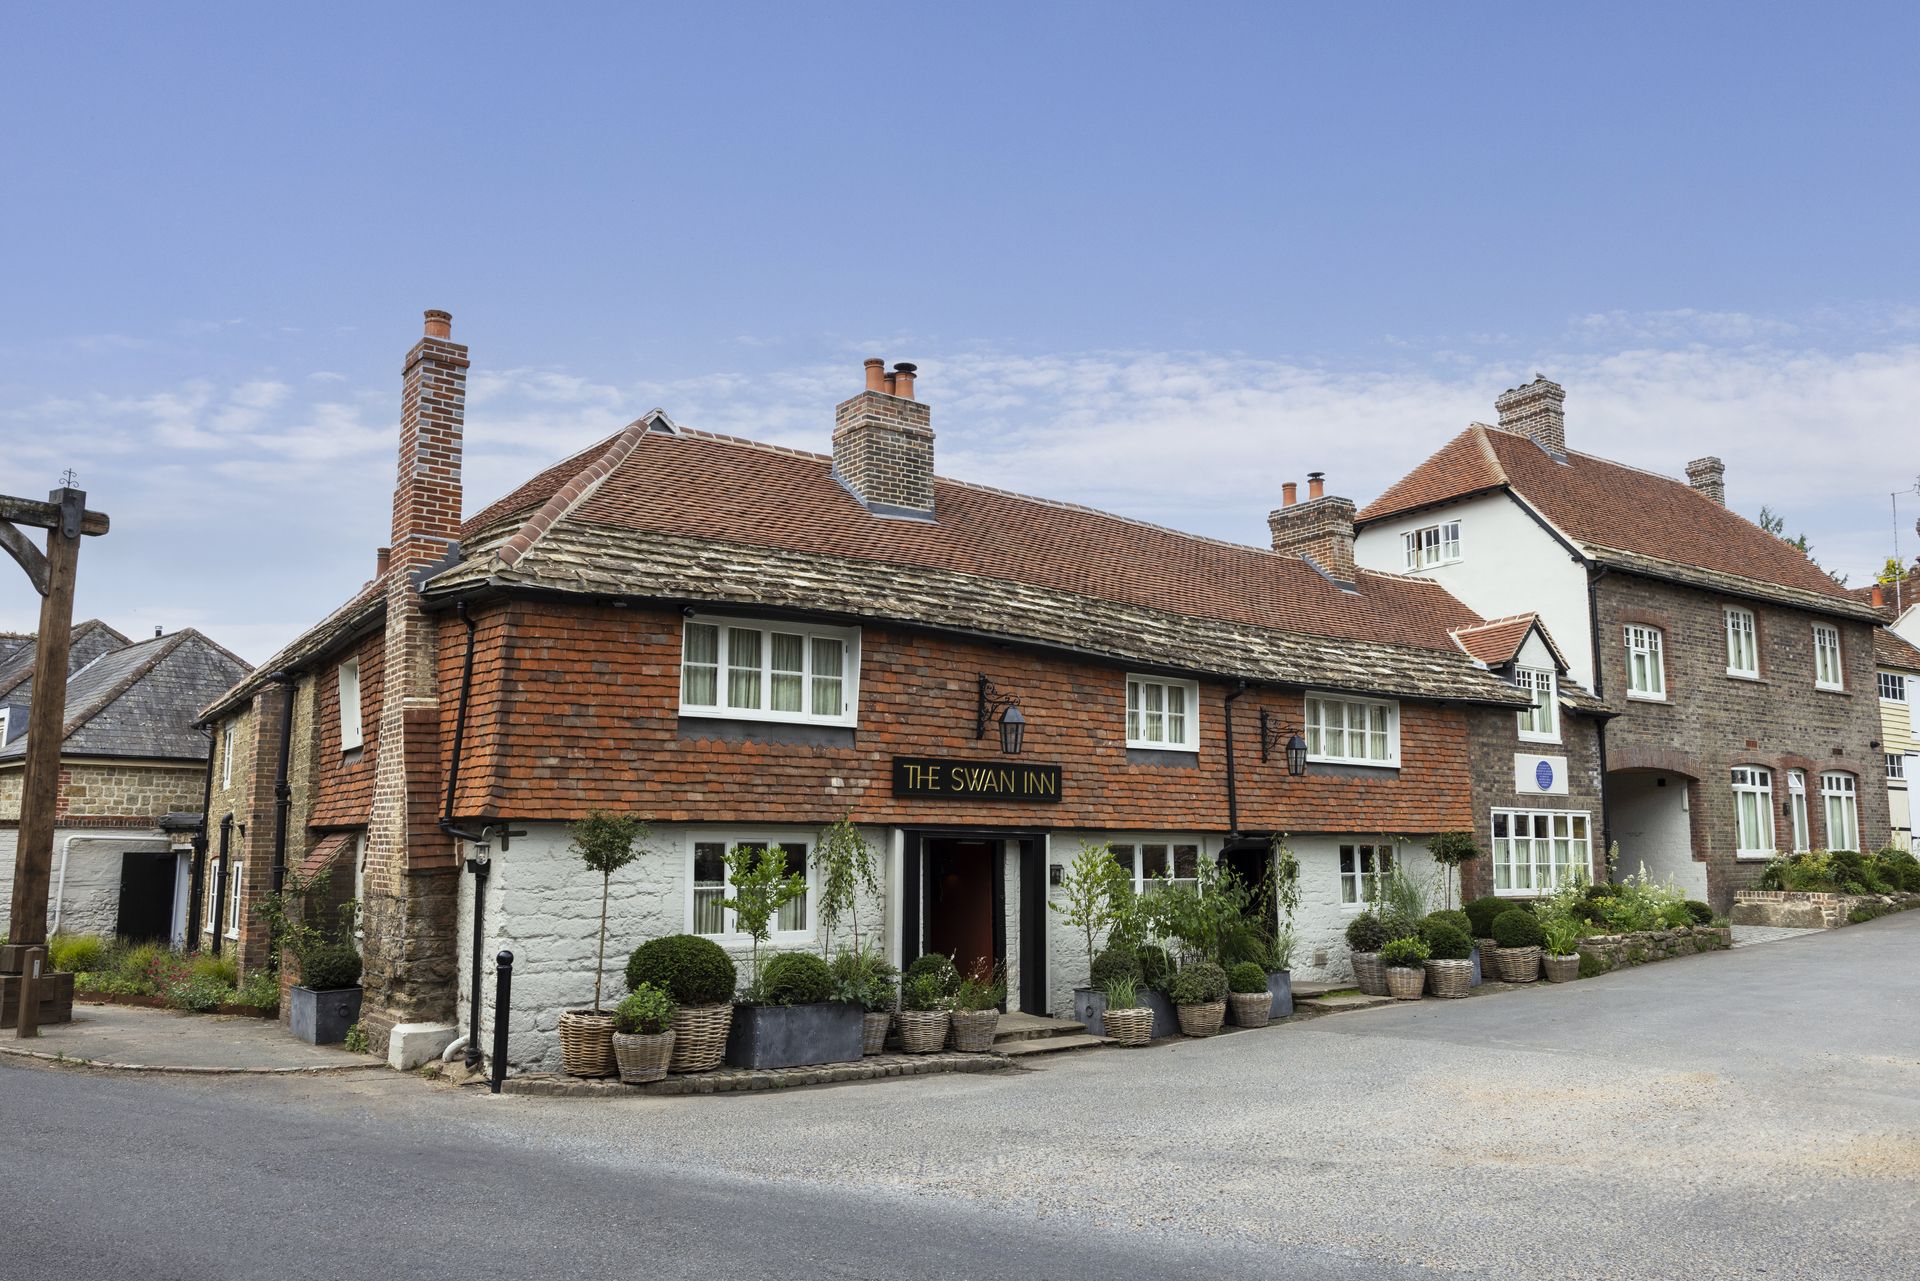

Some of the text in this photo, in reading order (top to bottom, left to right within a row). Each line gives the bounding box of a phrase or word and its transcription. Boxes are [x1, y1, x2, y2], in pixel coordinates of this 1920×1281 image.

[903, 764, 1055, 795] THE SWAN INN
